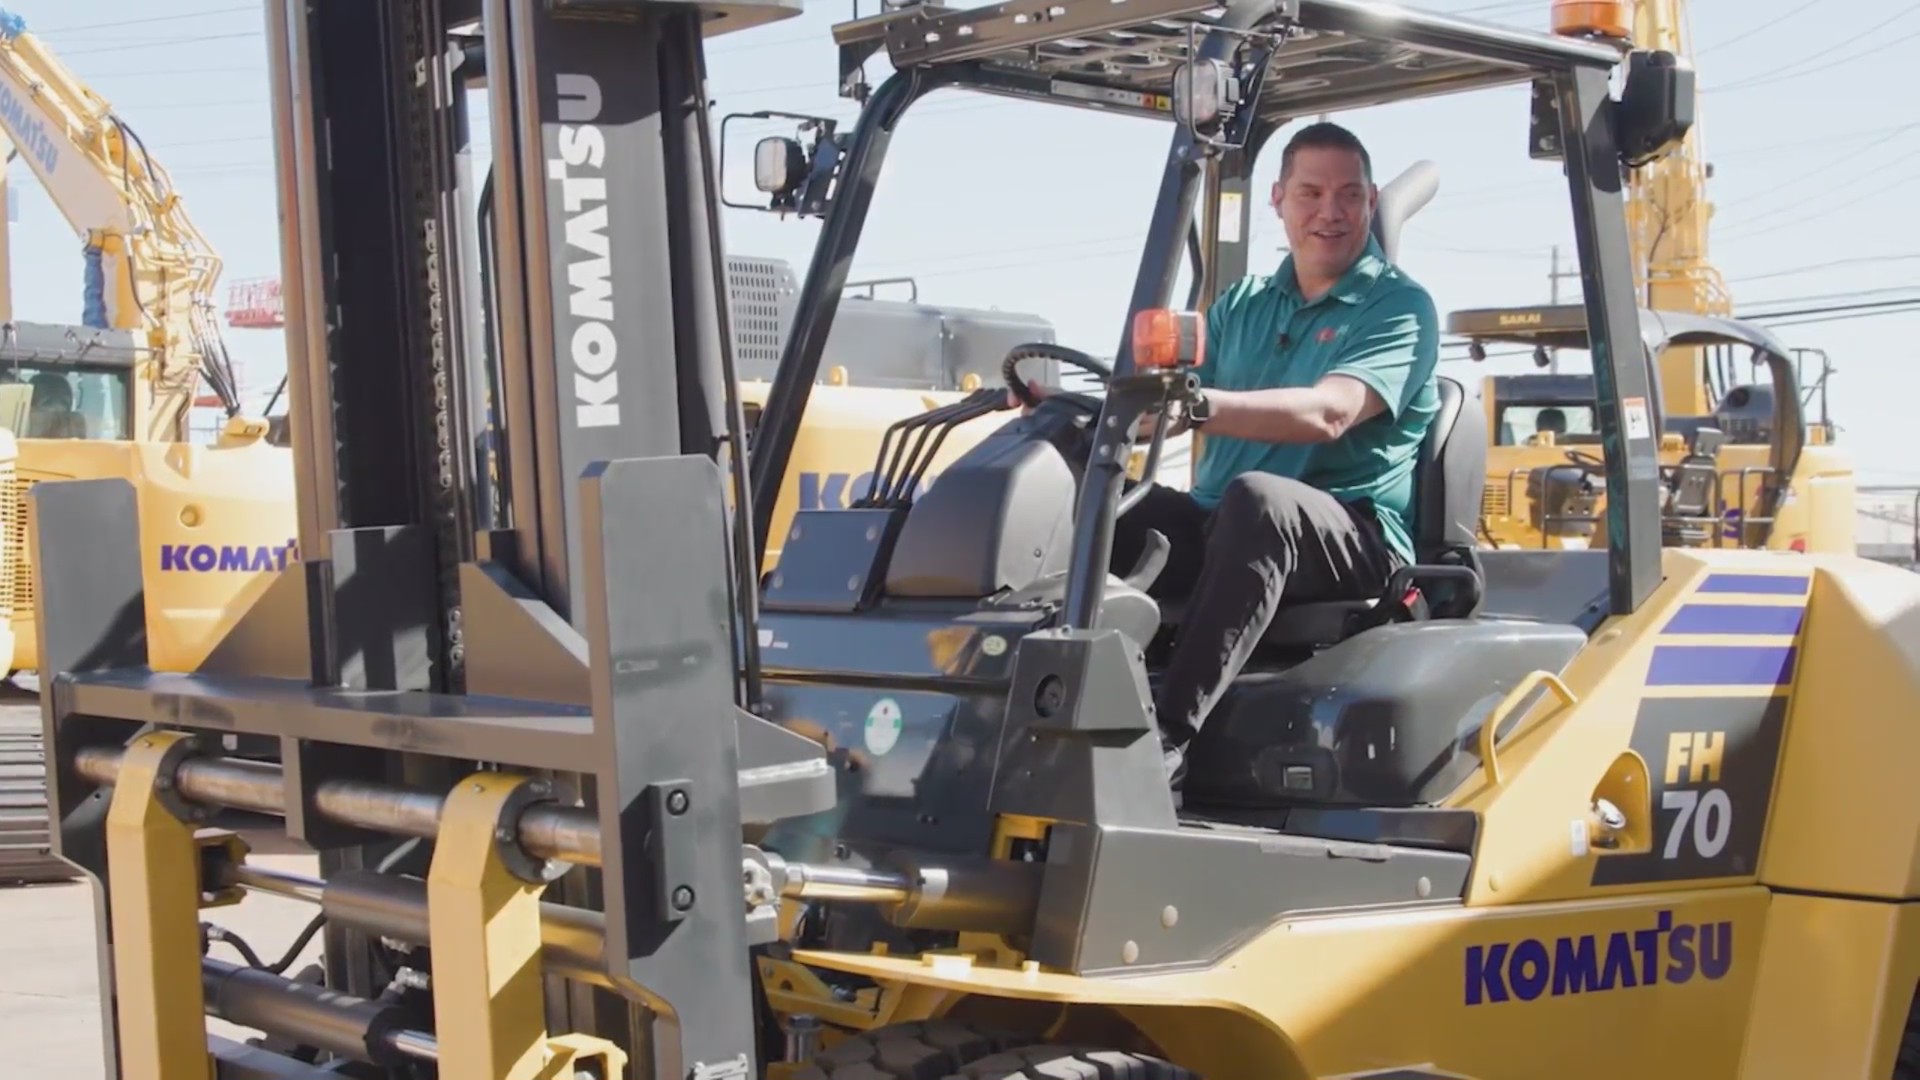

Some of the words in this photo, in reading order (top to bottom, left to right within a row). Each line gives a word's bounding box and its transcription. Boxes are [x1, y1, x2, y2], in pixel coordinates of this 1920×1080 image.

[0, 82, 58, 174] OMATSU
[549, 73, 620, 428] KOMATSU
[161, 538, 299, 571] KOMAT
[1665, 731, 1725, 784] FH
[1662, 788, 1731, 859] 70
[1465, 910, 1732, 1006] KOMATSU
